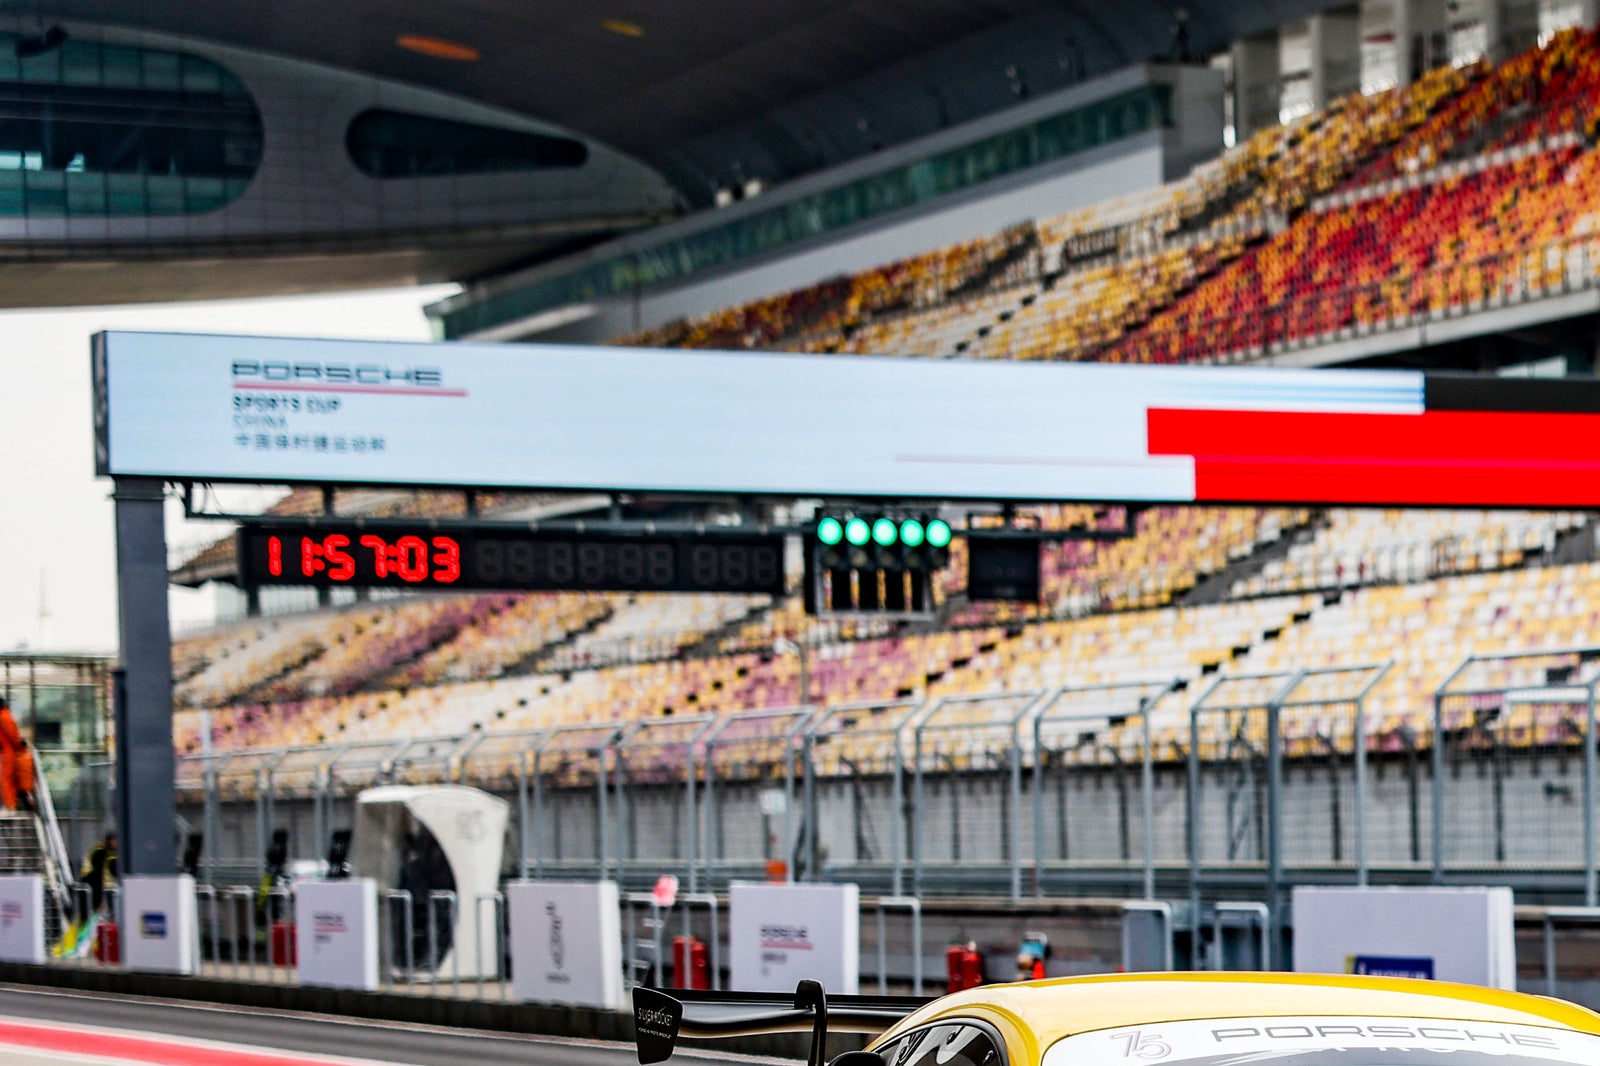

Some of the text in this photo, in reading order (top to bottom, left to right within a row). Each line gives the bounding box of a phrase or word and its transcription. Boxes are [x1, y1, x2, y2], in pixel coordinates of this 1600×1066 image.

[232, 362, 441, 386] PORSCHE
[268, 534, 460, 582] 11:57:03
[1211, 1025, 1561, 1050] PORSCHE
